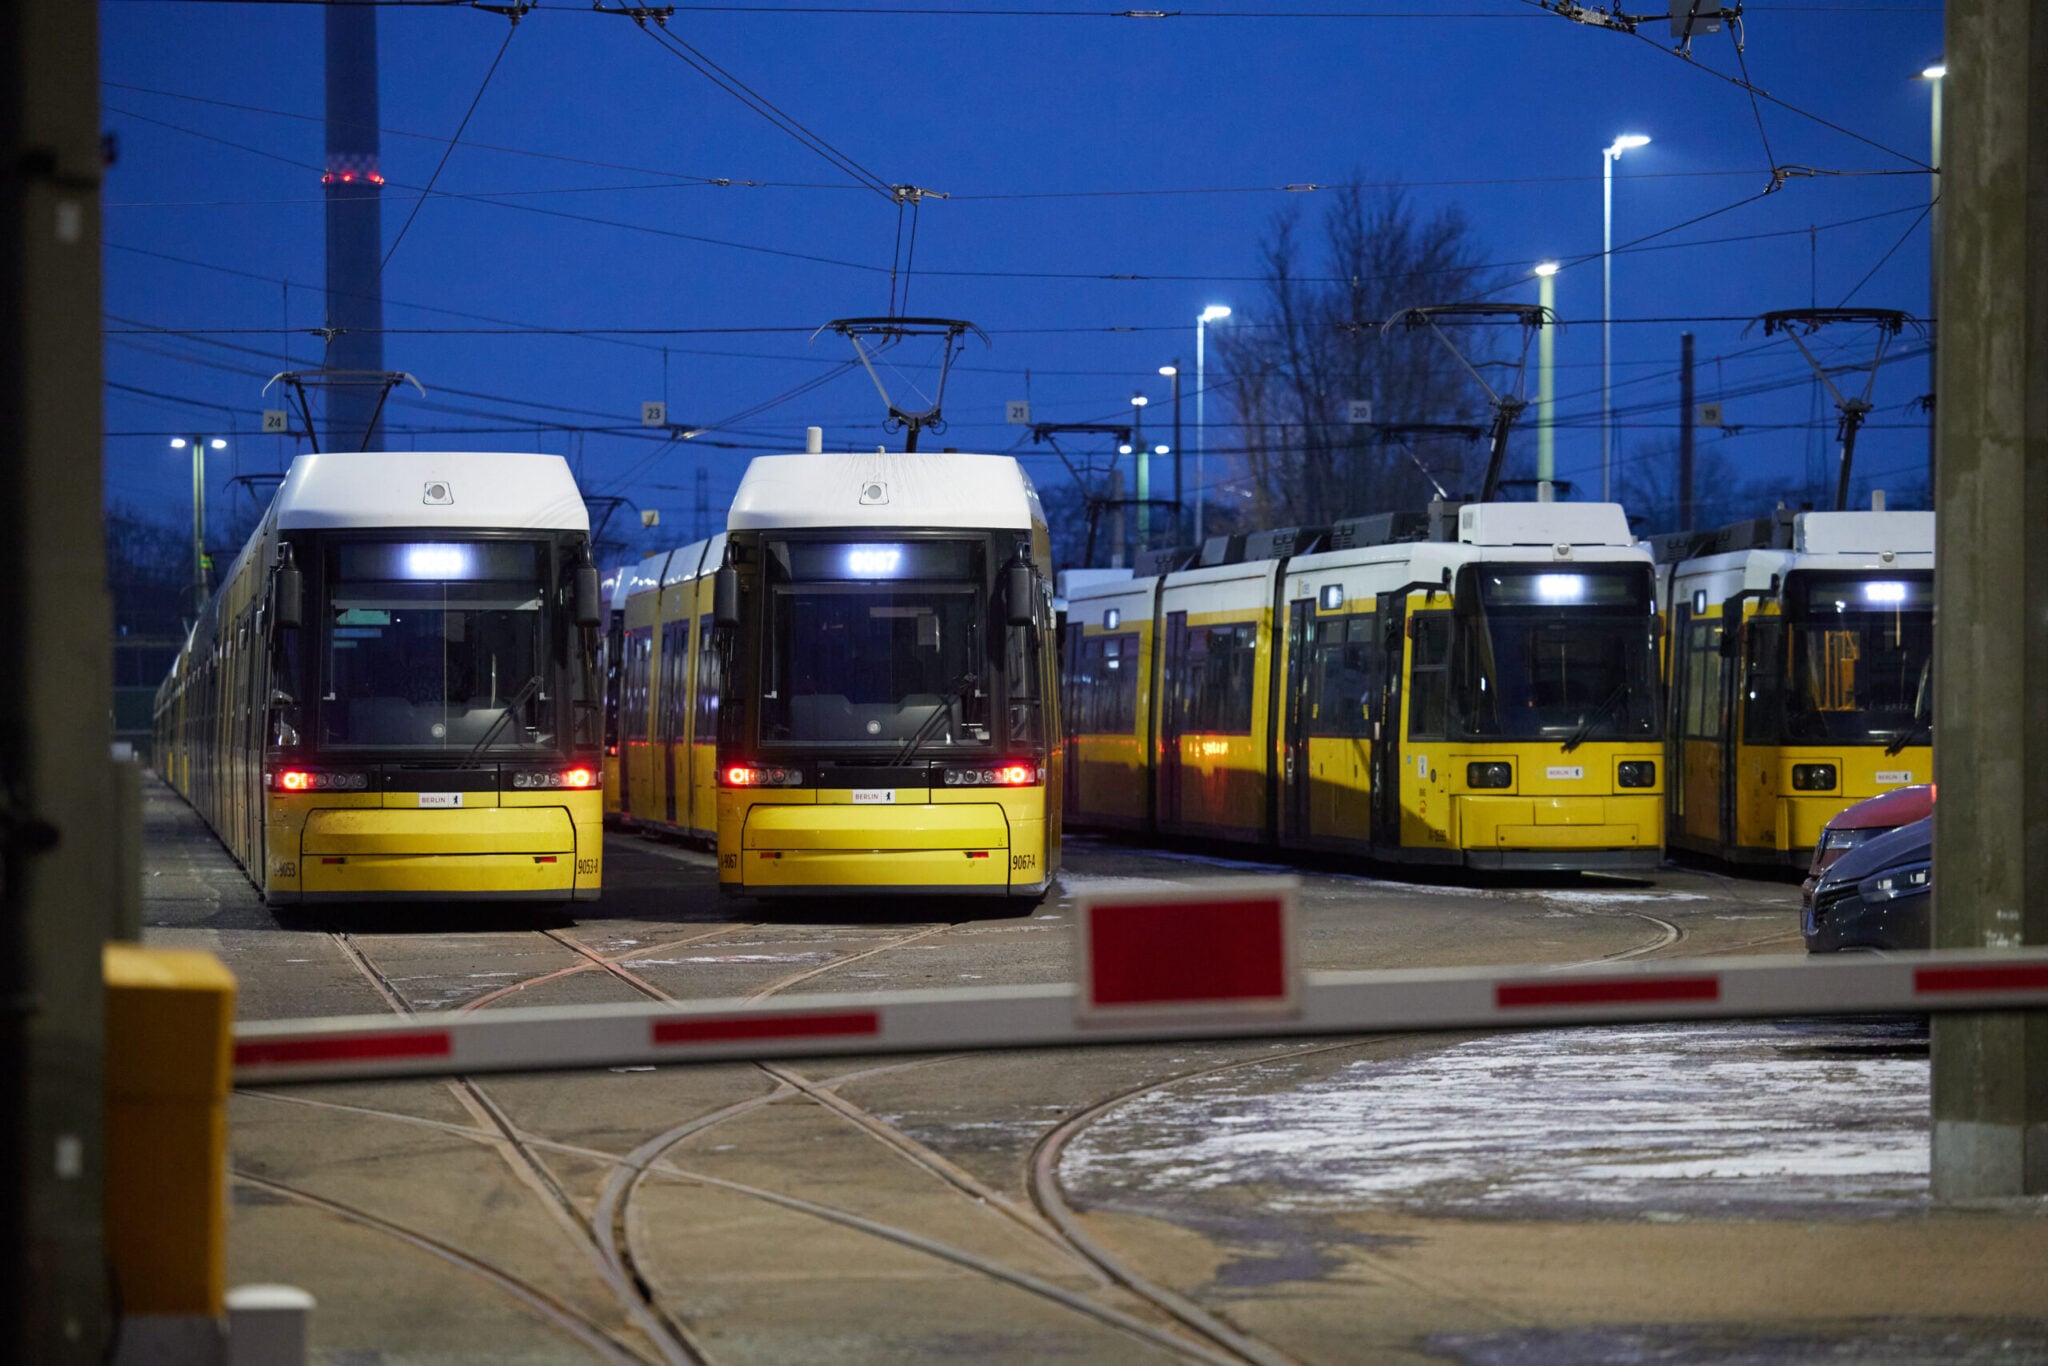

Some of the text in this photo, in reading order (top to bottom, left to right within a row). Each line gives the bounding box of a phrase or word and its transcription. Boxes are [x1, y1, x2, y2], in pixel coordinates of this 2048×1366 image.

[647, 407, 660, 420] 23
[1012, 407, 1024, 419] 21
[1353, 407, 1367, 419] 20
[268, 416, 281, 428] 24
[421, 796, 446, 804] BERLIN
[855, 793, 879, 801] BERLIN
[1012, 853, 1036, 871] 9067-A
[273, 861, 296, 878] -9053
